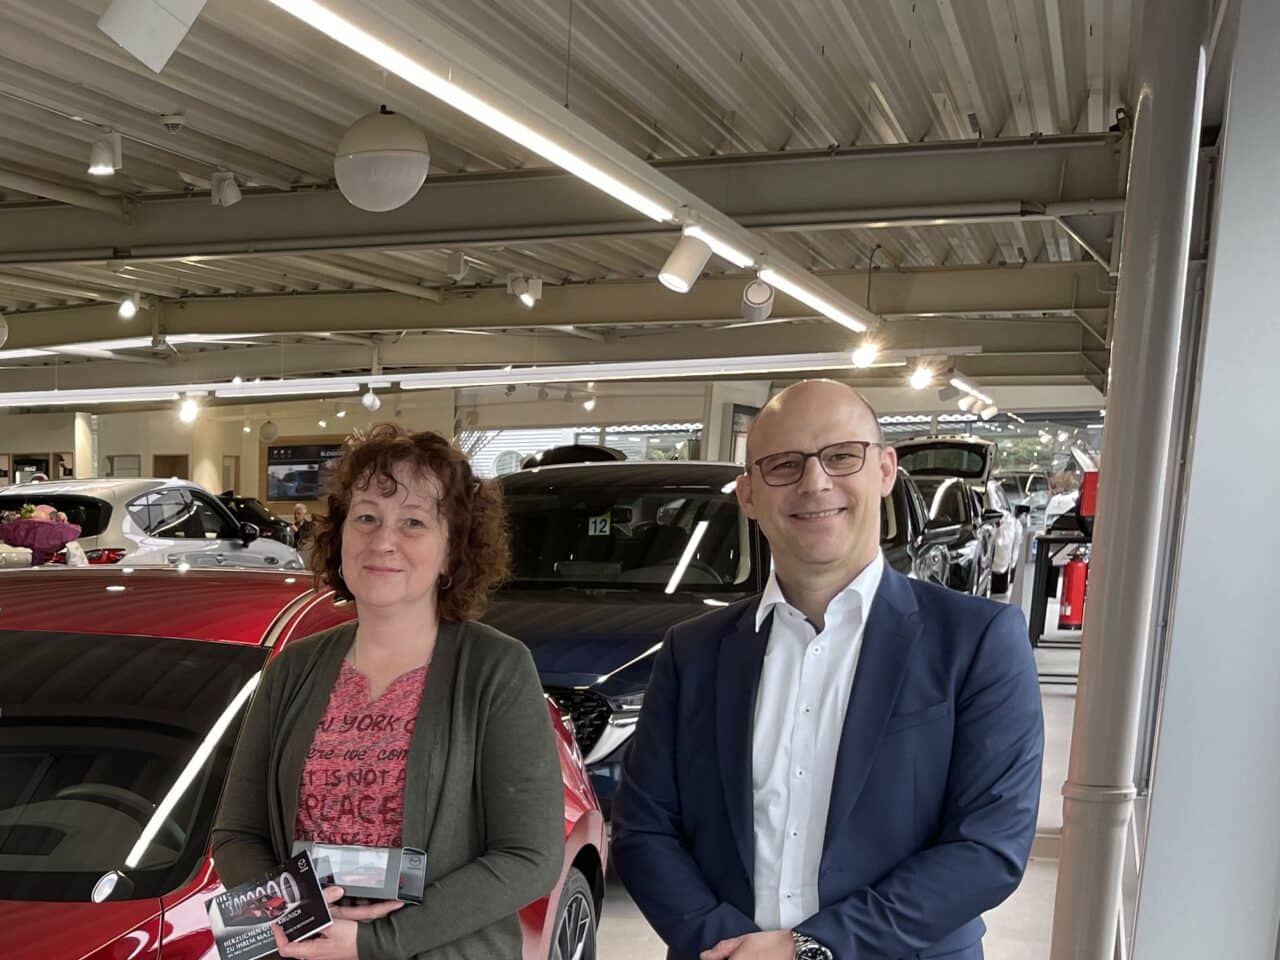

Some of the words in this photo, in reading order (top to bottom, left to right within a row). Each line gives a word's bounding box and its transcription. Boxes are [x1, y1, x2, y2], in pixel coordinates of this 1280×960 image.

[591, 516, 608, 533] 12
[340, 714, 402, 733] YORK
[346, 768, 391, 787] NOT
[304, 793, 403, 825] PLACE
